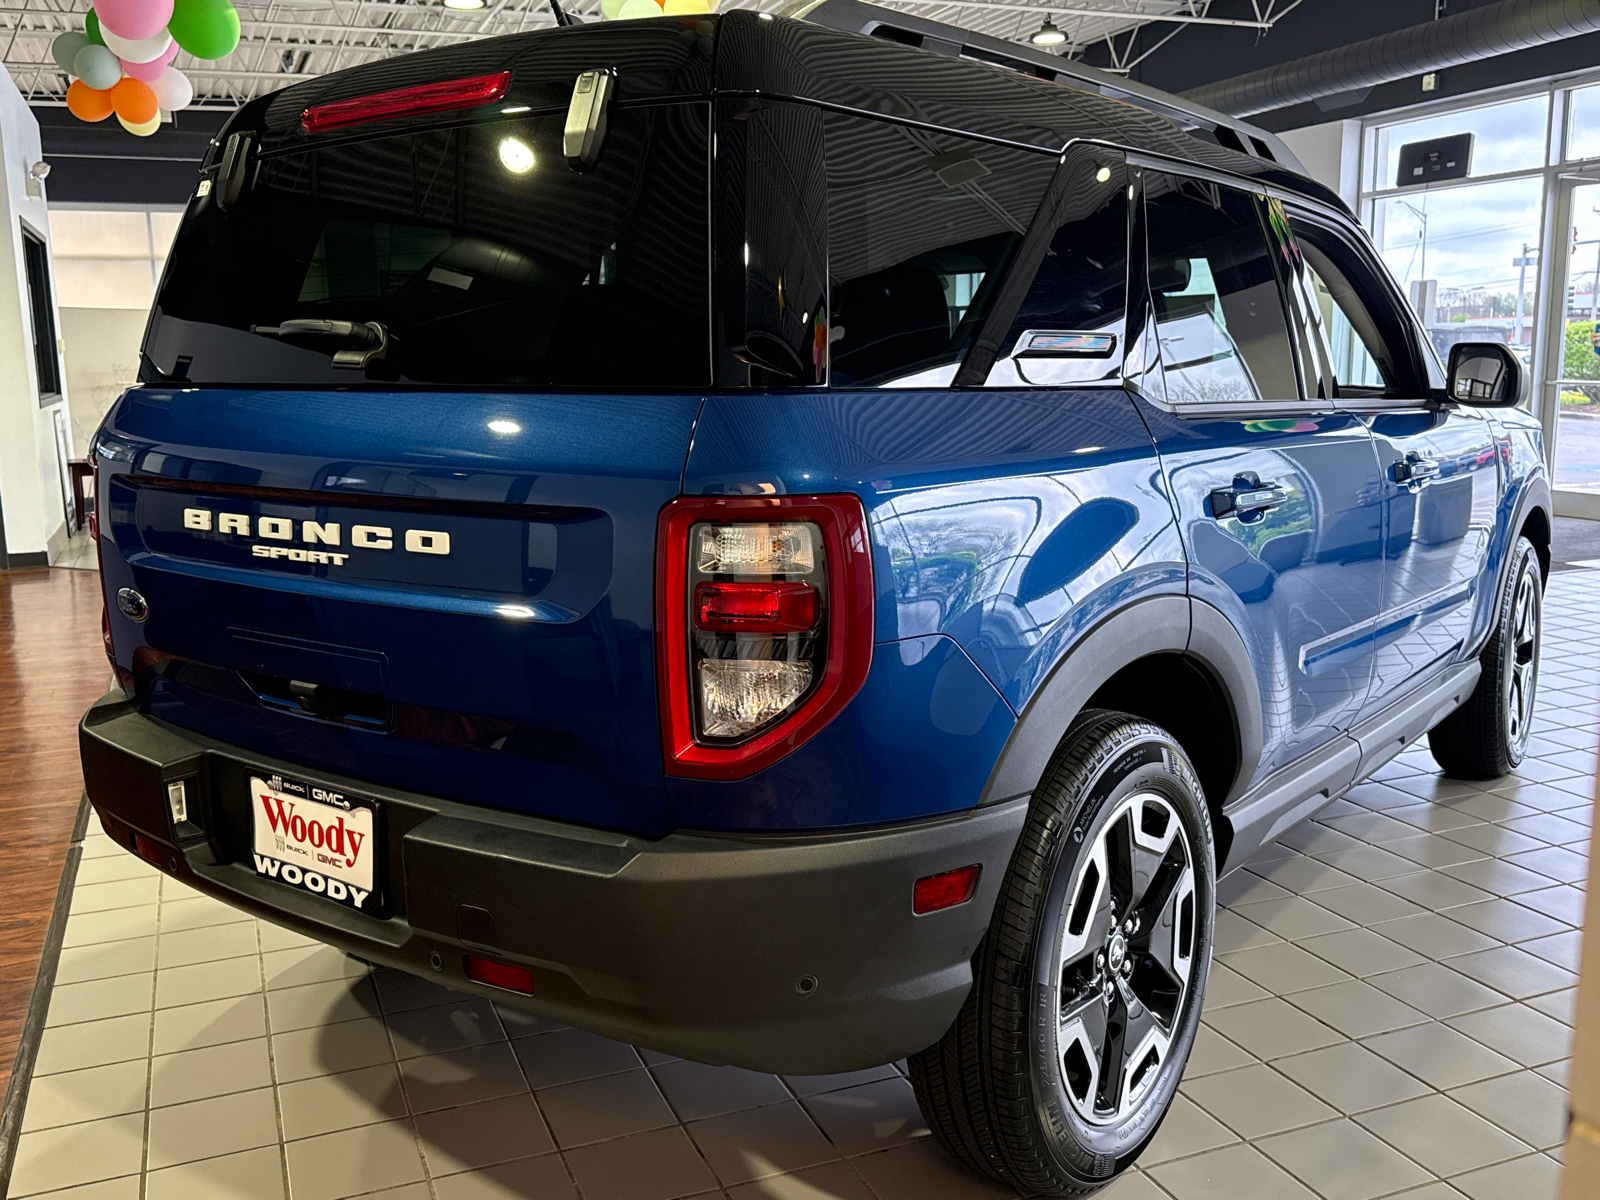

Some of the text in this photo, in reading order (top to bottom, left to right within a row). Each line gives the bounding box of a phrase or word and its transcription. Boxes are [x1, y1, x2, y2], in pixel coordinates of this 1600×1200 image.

[183, 508, 450, 555] BRONCO
[252, 545, 349, 566] SPORT
[283, 782, 344, 806] BUICK GMC
[1182, 766, 1212, 839] MICHELIN
[259, 794, 365, 868] Woody
[286, 844, 343, 869] BUICK GMC
[253, 854, 369, 909] WOODY
[1039, 993, 1047, 1008] 18
[1038, 1017, 1046, 1026] R
